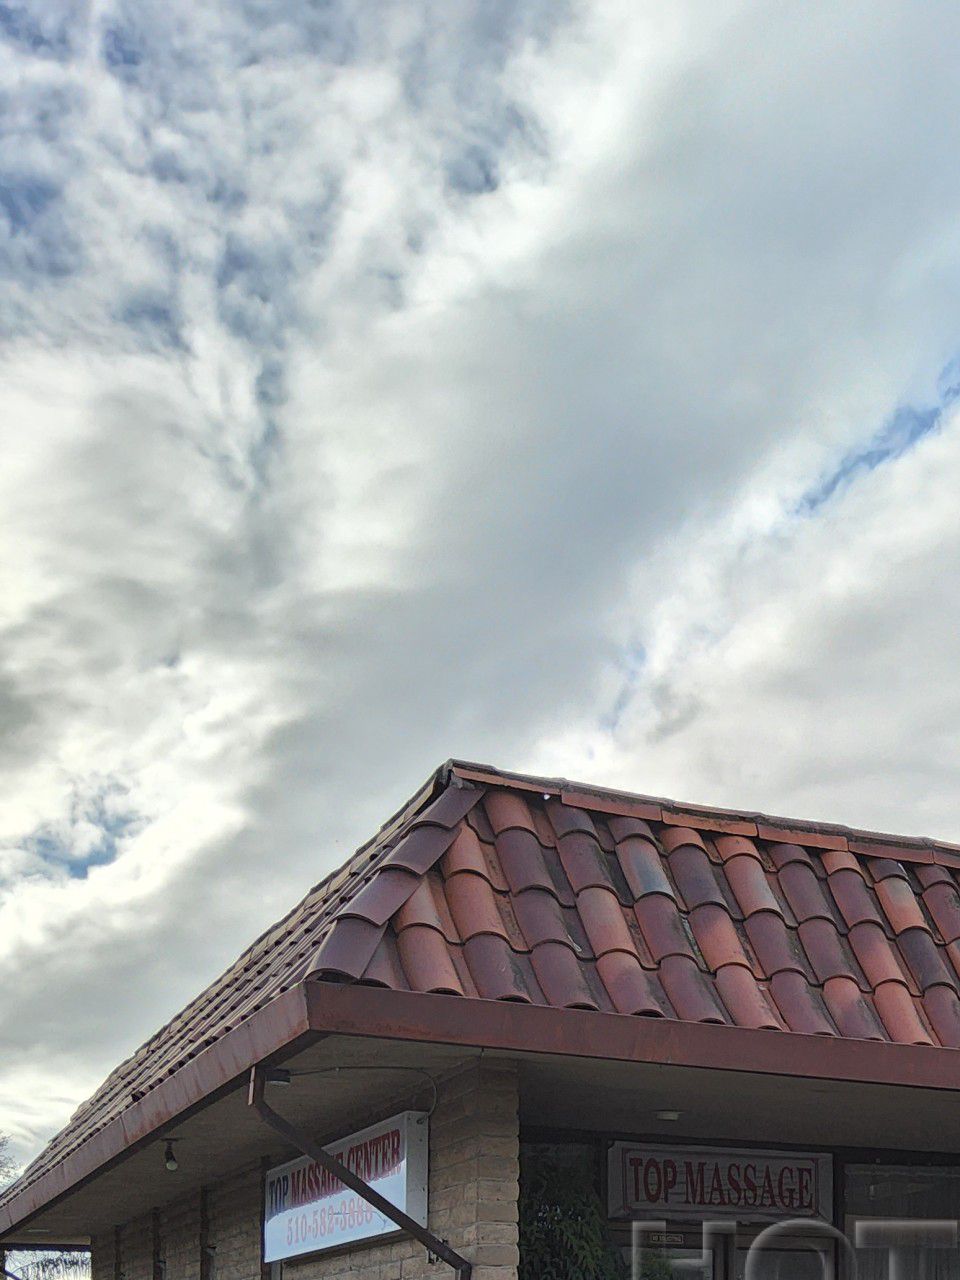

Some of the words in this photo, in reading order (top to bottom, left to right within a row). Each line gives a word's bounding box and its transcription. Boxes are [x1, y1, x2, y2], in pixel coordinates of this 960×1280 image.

[269, 1174, 289, 1215] TOP
[346, 1128, 401, 1183] CENTER
[629, 1157, 677, 1204] TOP
[684, 1160, 813, 1209] MASSAGE
